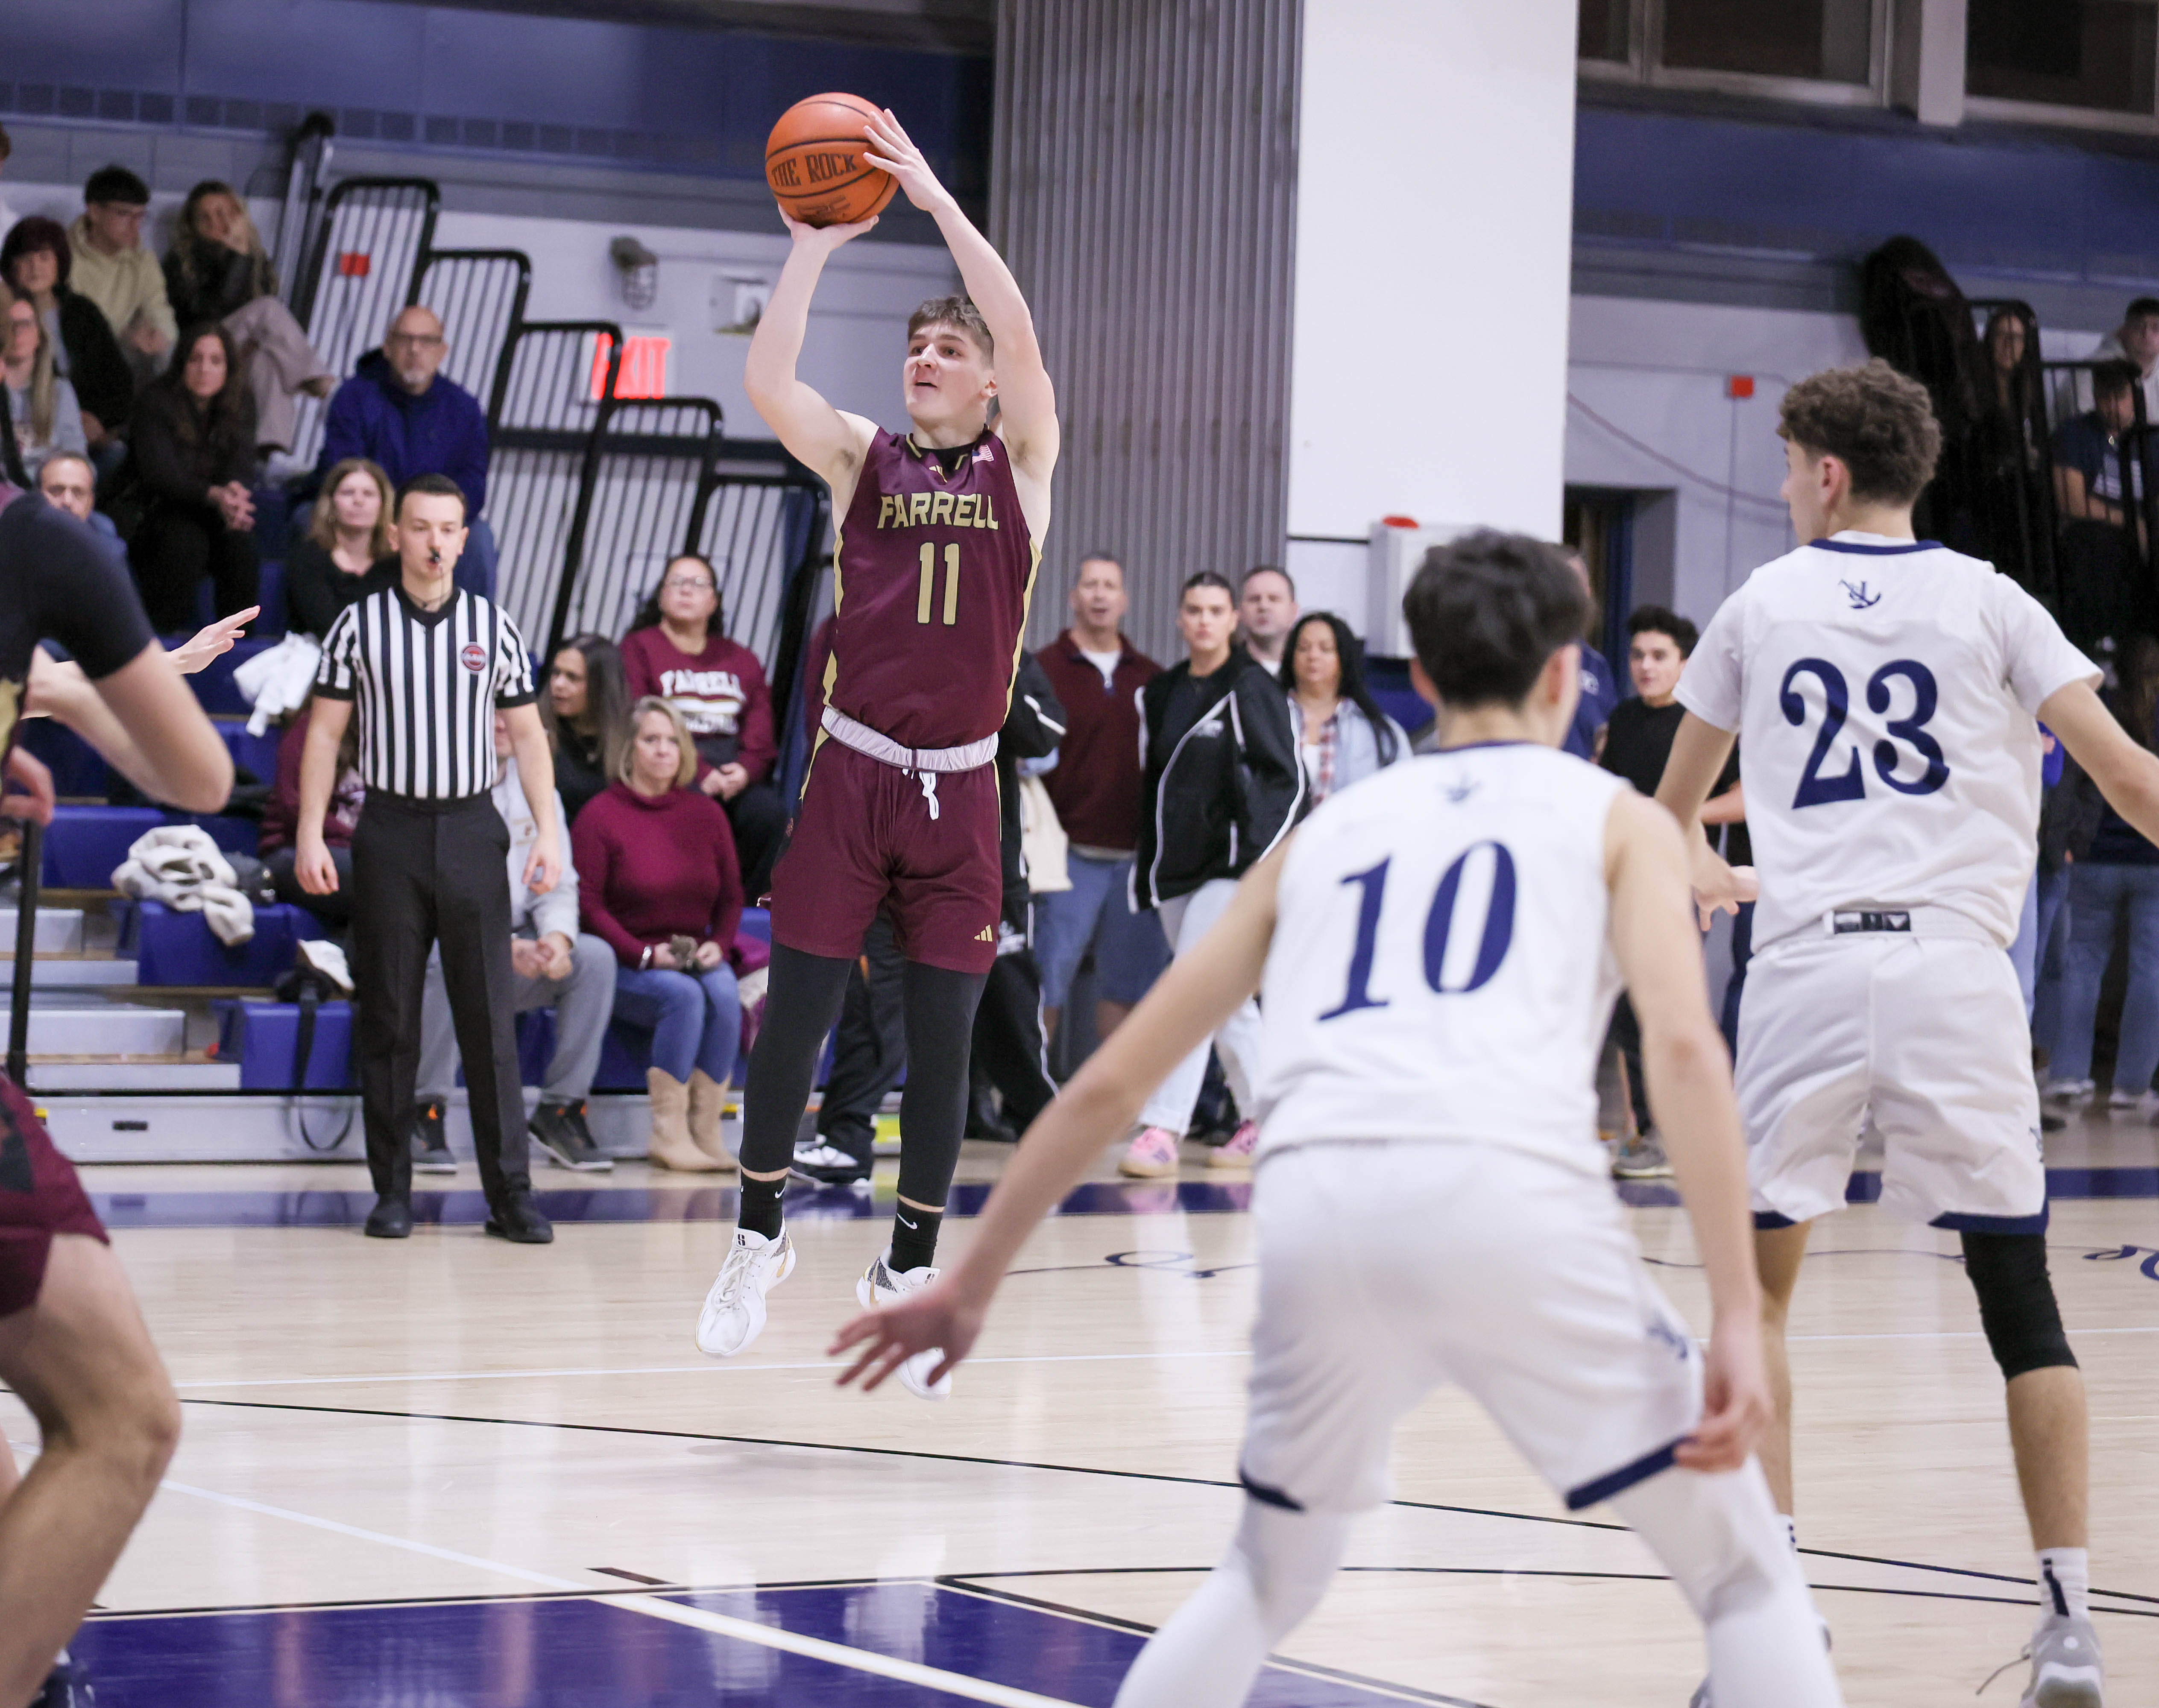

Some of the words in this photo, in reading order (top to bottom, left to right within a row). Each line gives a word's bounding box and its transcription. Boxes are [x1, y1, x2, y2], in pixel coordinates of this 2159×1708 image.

[771, 158, 801, 186] THE
[805, 153, 857, 184] ROCK
[877, 491, 999, 530] FARRELL
[917, 542, 960, 625] 11
[1780, 658, 1950, 809] 23
[1318, 839, 1516, 1021] 10
